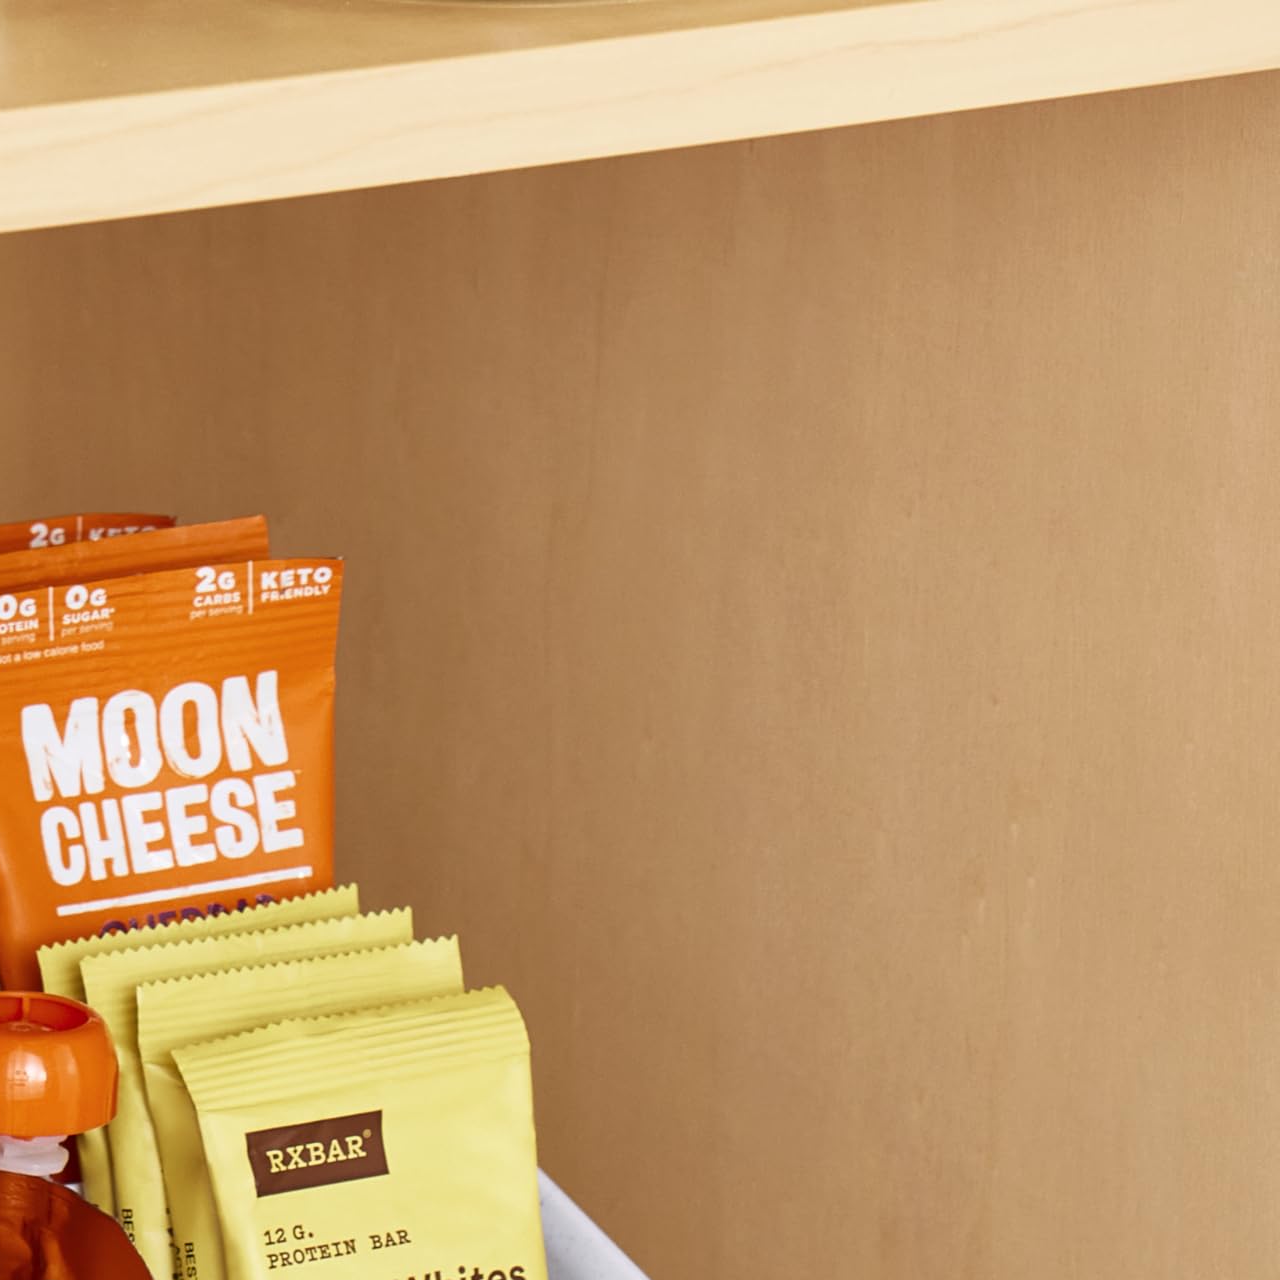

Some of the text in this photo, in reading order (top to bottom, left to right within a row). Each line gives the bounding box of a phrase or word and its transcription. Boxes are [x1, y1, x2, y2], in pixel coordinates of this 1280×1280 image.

[261, 566, 333, 590] KETO
[193, 592, 241, 607] CARBS
[21, 670, 289, 802] MOON
[40, 770, 305, 887] CHEESE
[266, 1135, 367, 1173] RXBAR
[263, 1224, 315, 1246] 12 G.
[266, 1229, 412, 1270] PROTEIN BAR
